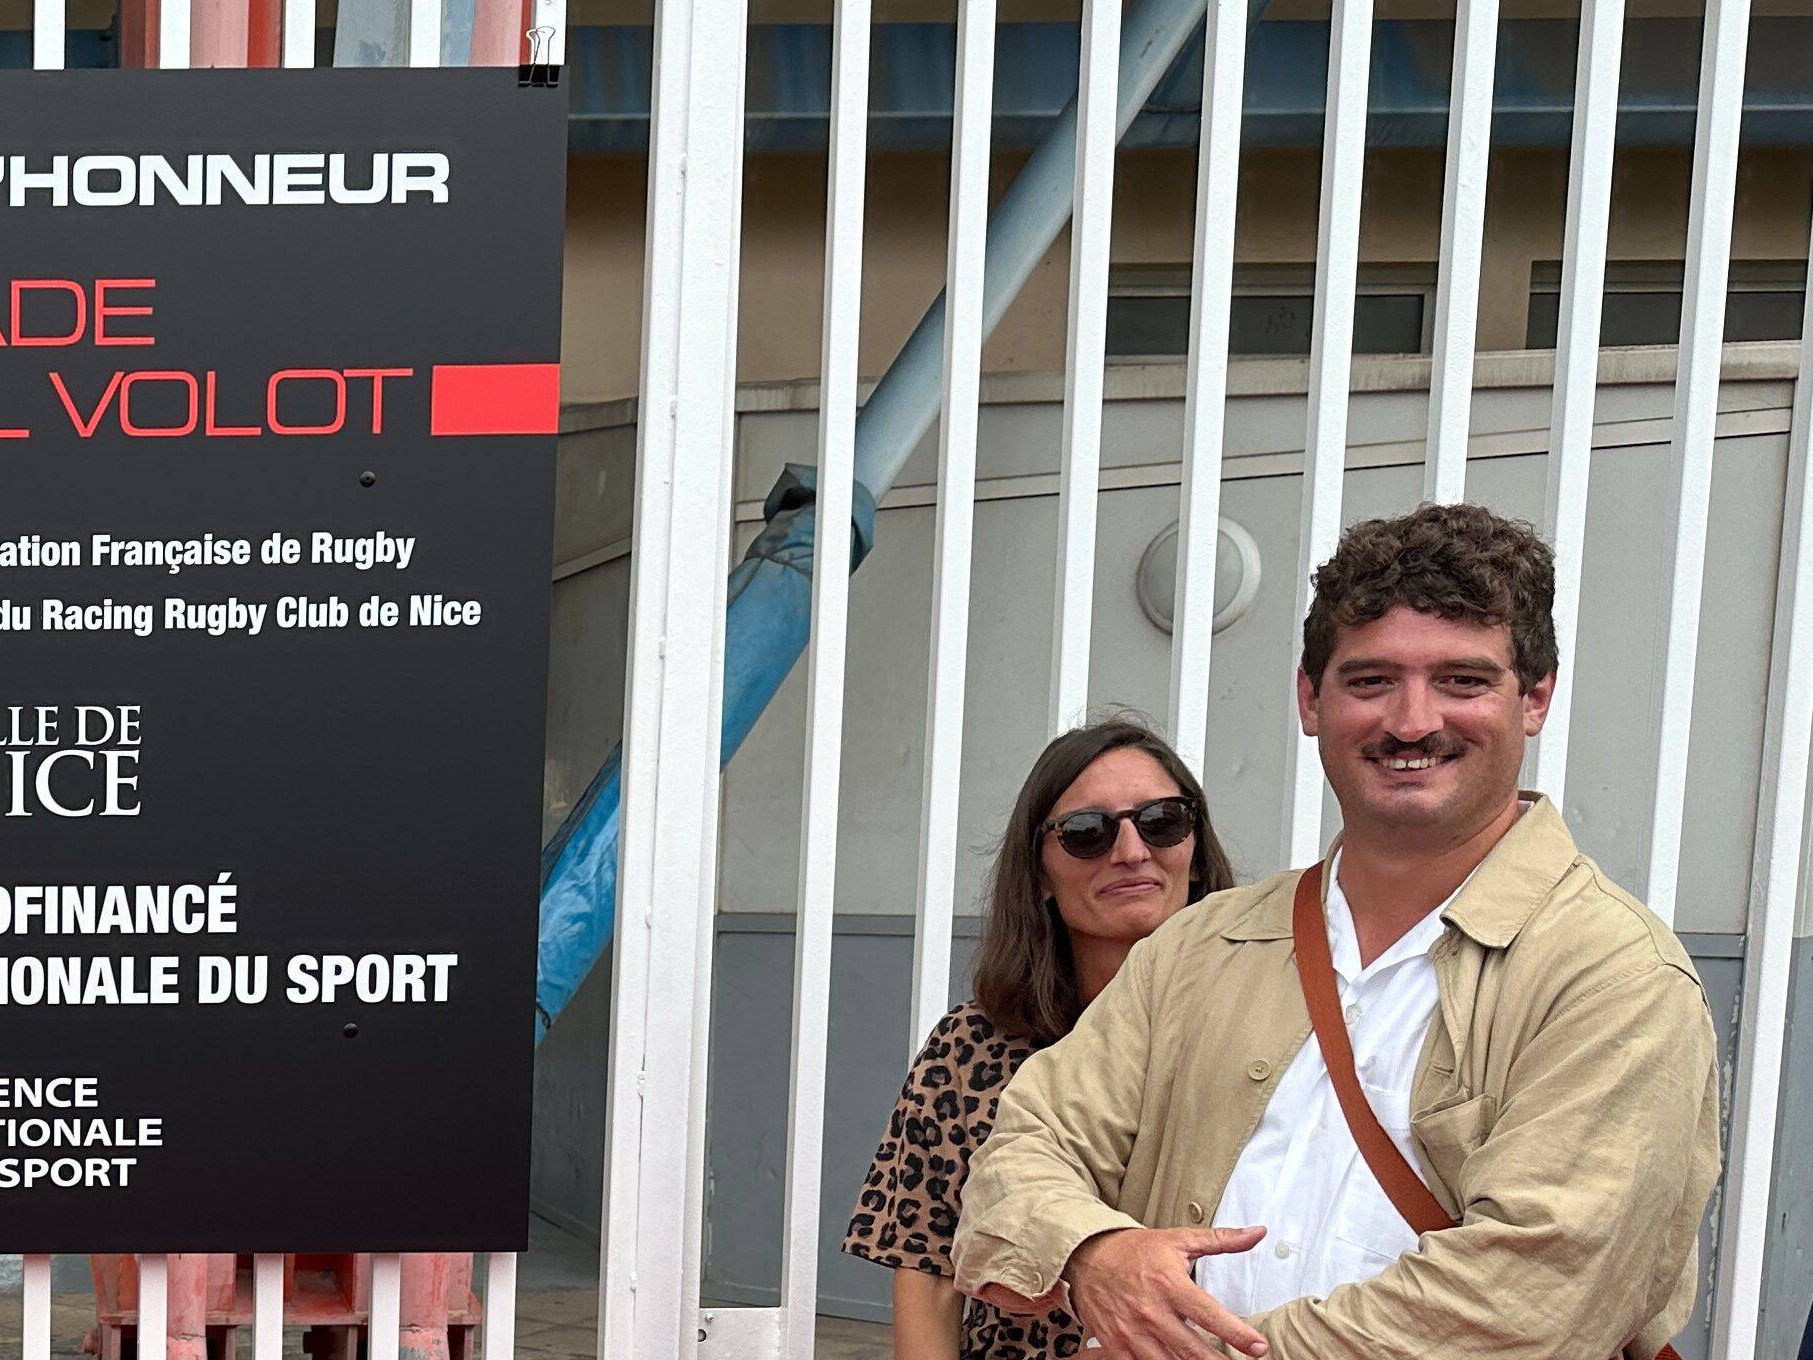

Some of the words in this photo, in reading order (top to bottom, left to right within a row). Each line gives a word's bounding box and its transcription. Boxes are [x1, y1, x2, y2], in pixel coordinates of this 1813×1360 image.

[49, 368, 413, 437] VOLOT
[92, 534, 250, 574] Française
[261, 533, 300, 564] de
[312, 531, 415, 570] Rugby
[43, 599, 153, 636] Racing
[165, 598, 267, 635] Rugby
[277, 596, 348, 628] Club
[359, 596, 399, 627] de
[410, 595, 481, 626] Nice
[74, 706, 141, 745] DE
[199, 956, 268, 1004] DU
[287, 954, 458, 1003] SPORT
